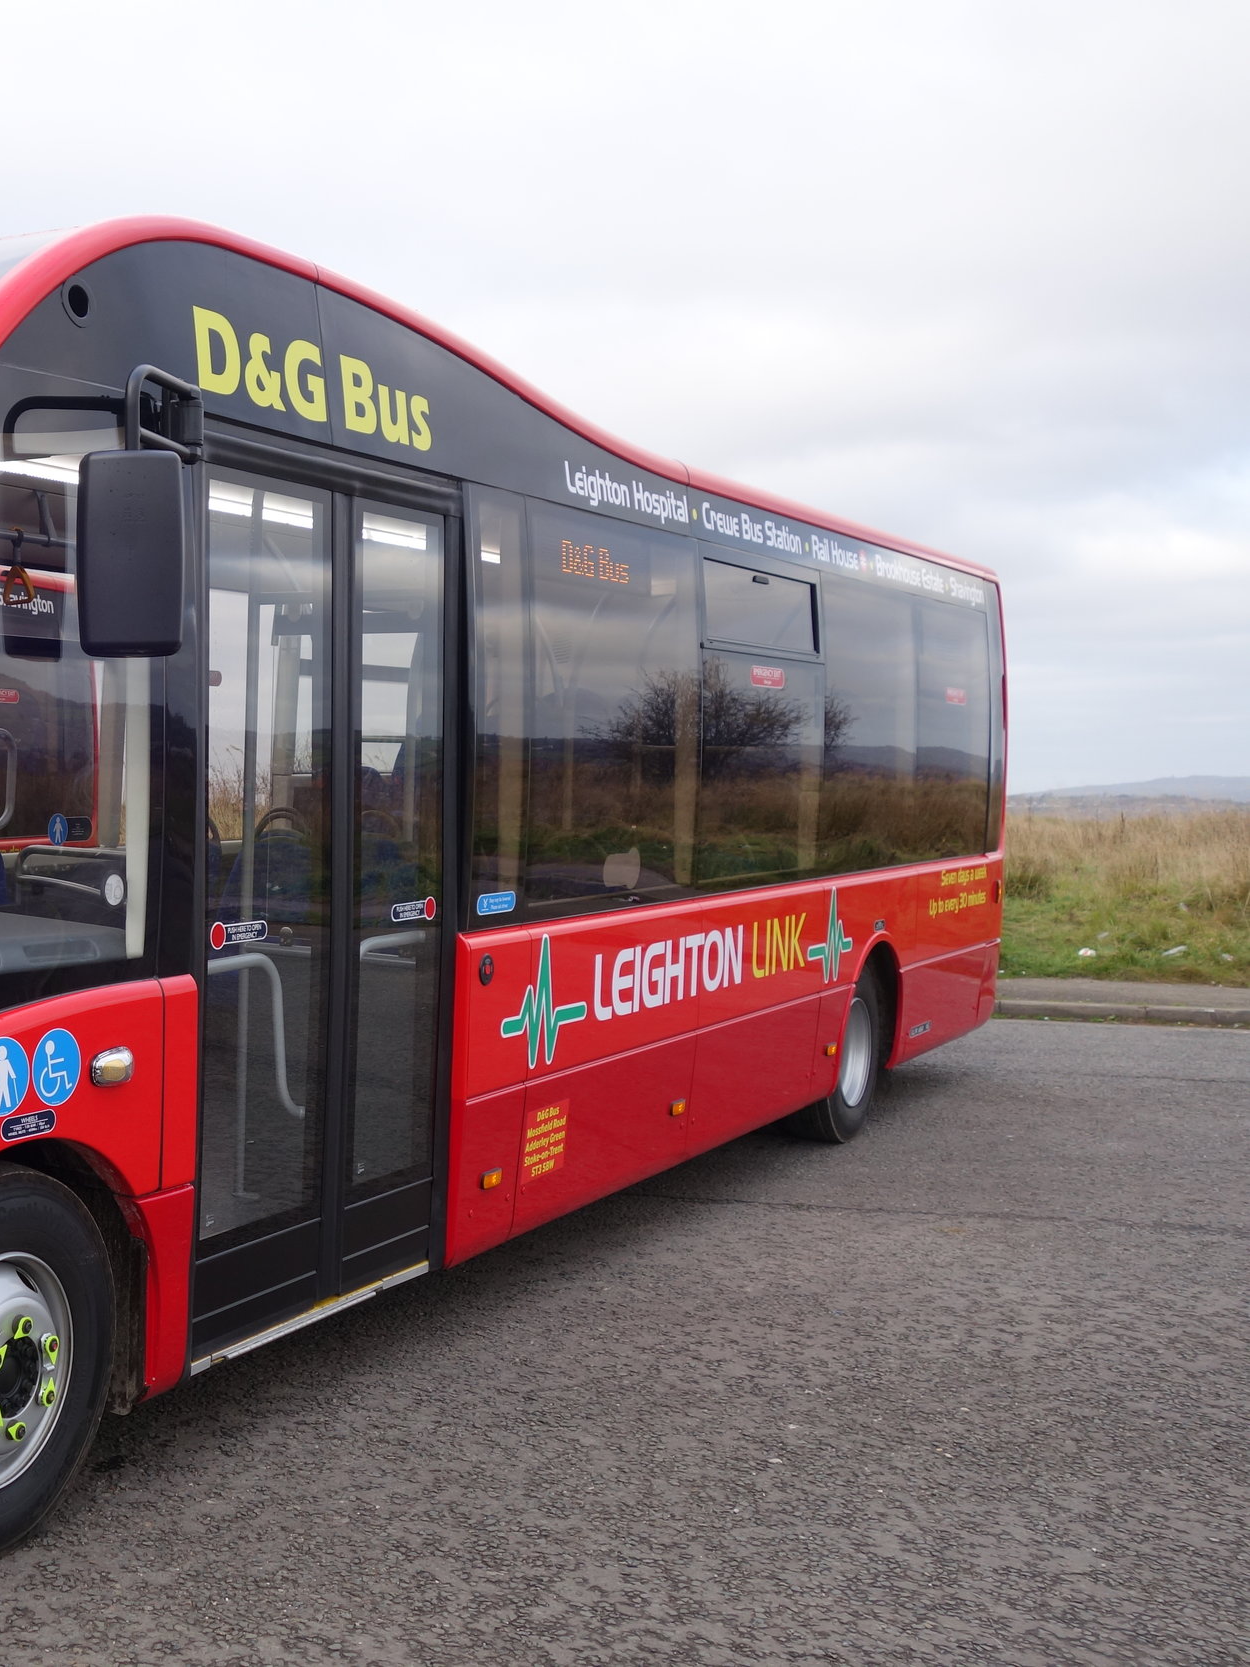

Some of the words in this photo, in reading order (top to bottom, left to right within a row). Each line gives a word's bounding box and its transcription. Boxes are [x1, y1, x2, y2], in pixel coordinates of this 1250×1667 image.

[192, 305, 327, 422] D&G
[339, 354, 432, 451] Bus
[564, 460, 630, 508] Leighton
[632, 480, 689, 525] Hospital
[702, 501, 740, 539] Crewe
[740, 512, 764, 545] Bus
[764, 520, 802, 555] Station
[811, 534, 831, 563] Rail
[831, 541, 859, 571] House
[562, 540, 595, 578] D&G
[598, 548, 630, 584] Bus
[252, 923, 262, 931] OPEN
[593, 924, 744, 1021] LEIGHTON
[752, 912, 807, 978] LINK
[549, 1106, 560, 1118] Bus
[553, 1115, 567, 1129] Road
[524, 1136, 550, 1154] Adderley
[550, 1131, 565, 1144] Green
[531, 1163, 542, 1177] ST3
